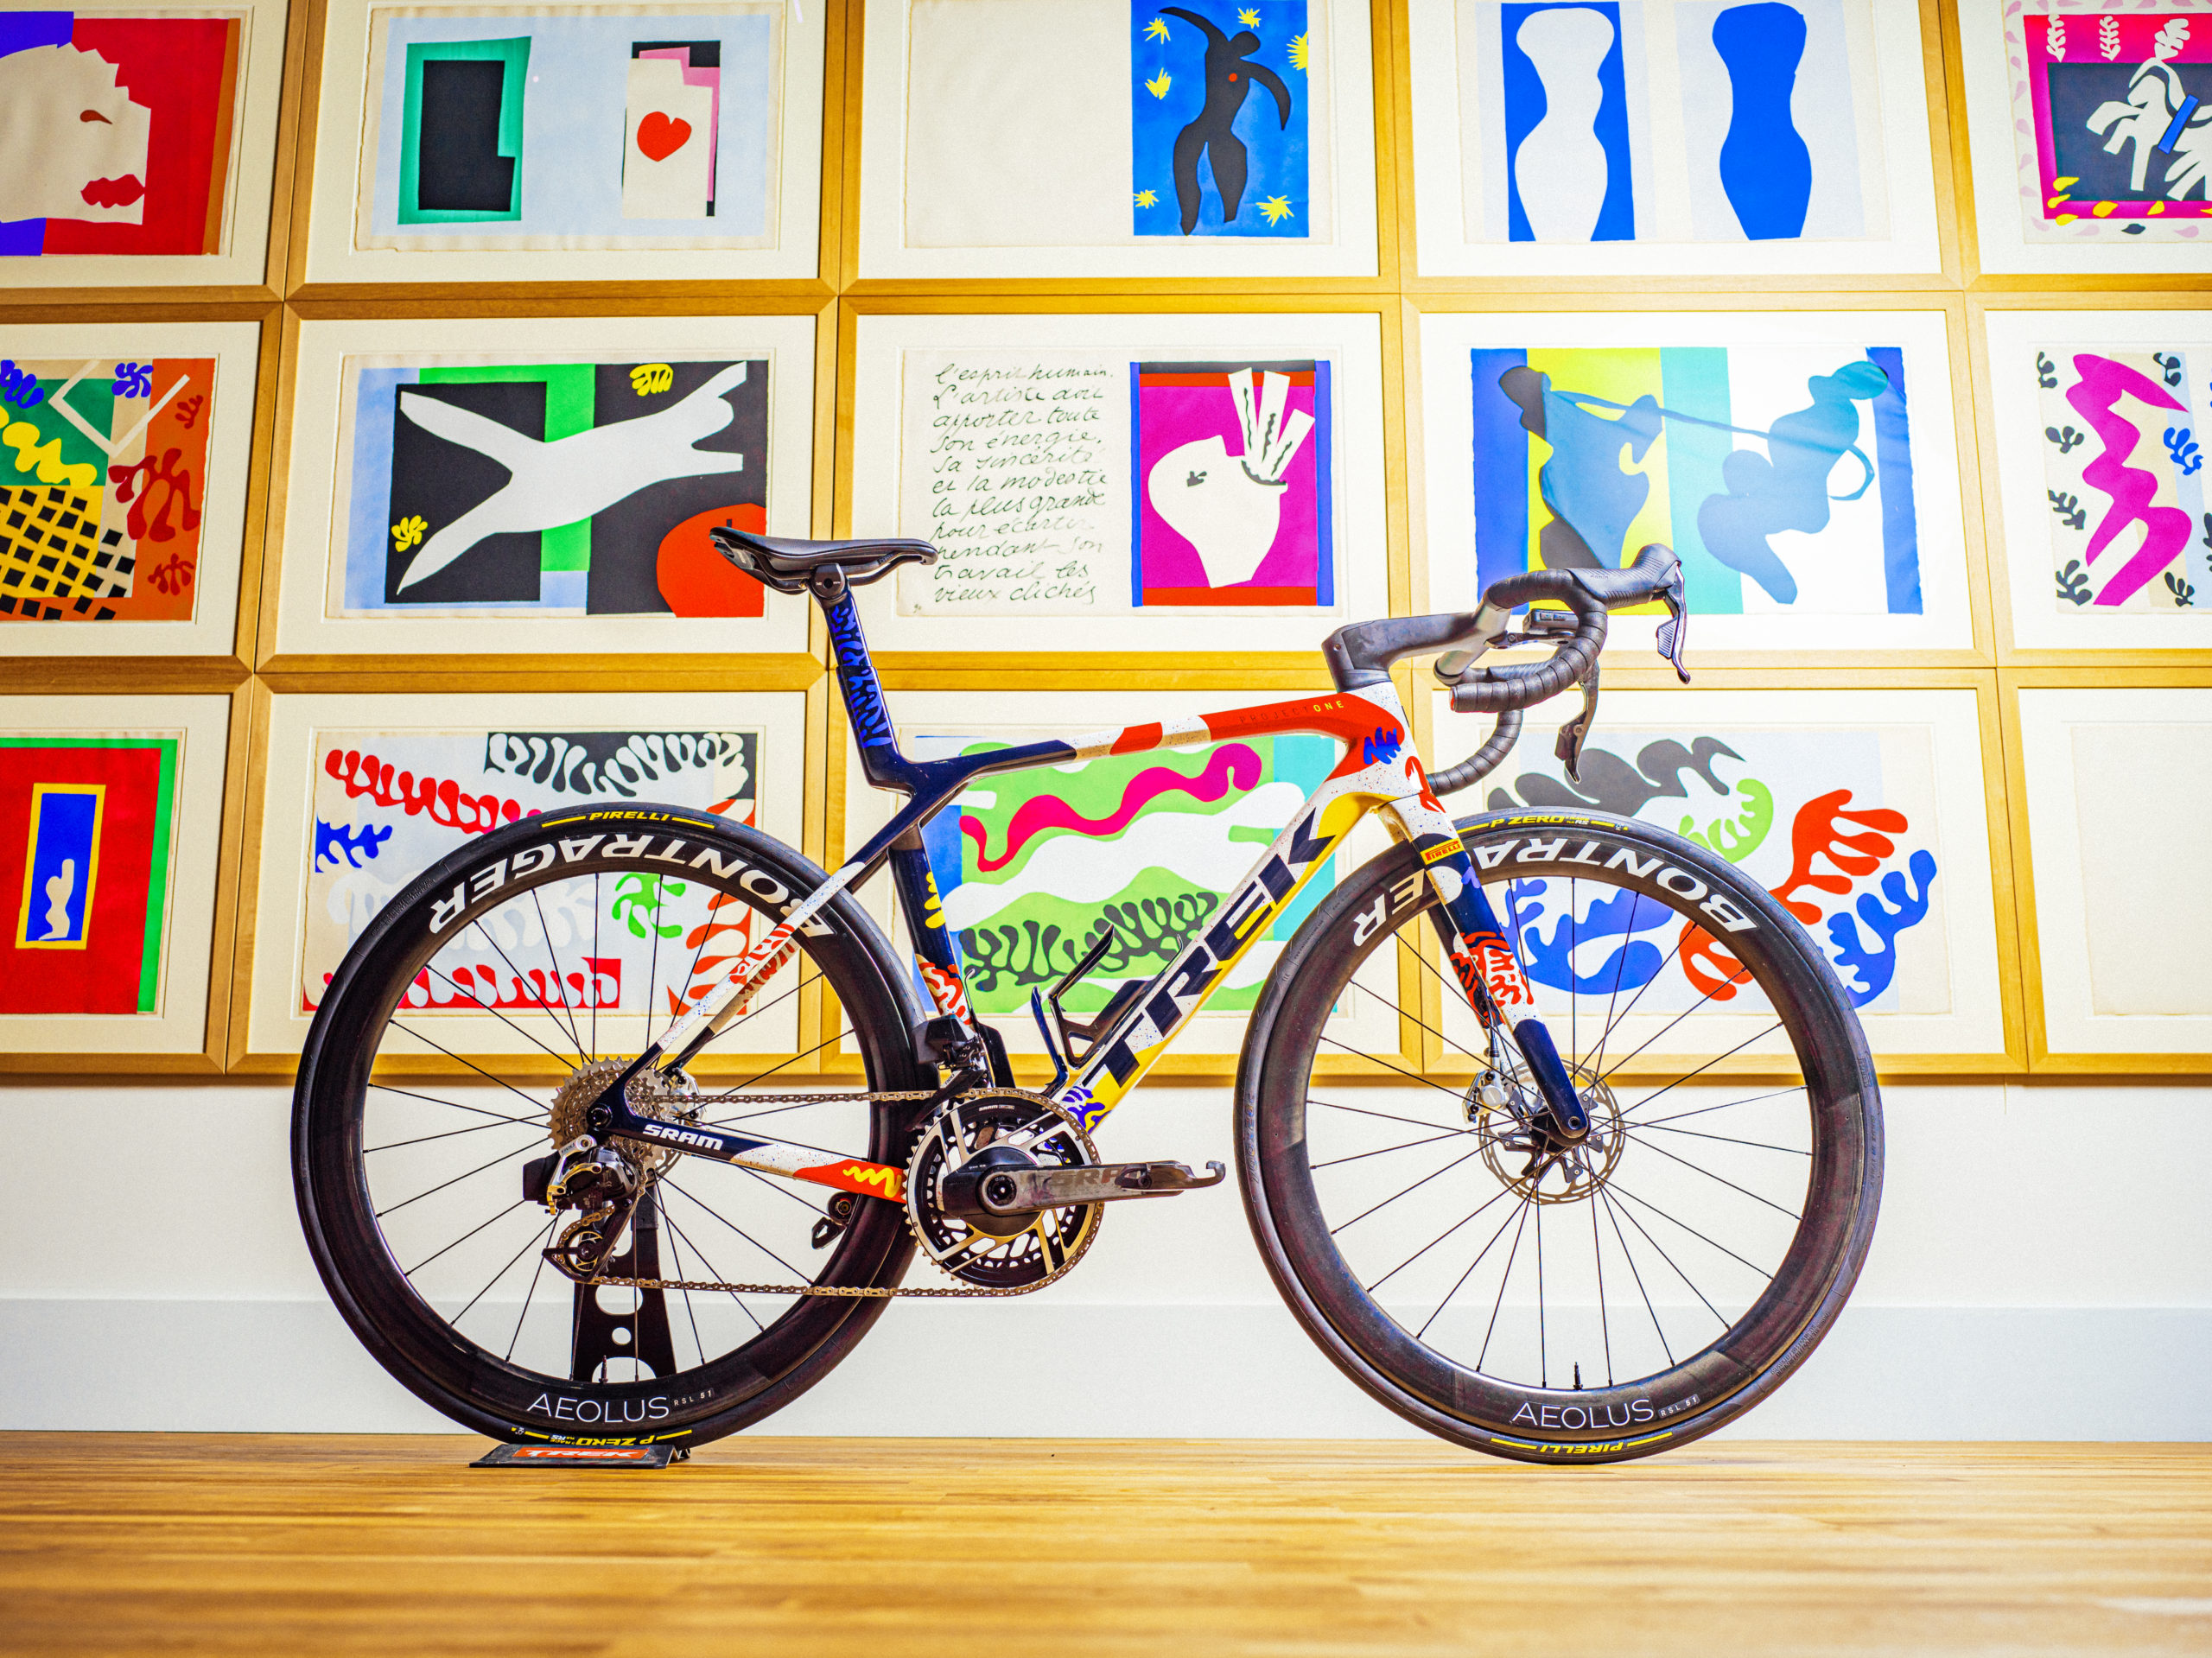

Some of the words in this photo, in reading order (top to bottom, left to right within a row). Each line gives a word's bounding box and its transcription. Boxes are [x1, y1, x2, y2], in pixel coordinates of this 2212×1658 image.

[1052, 385, 1103, 401] doit
[932, 409, 1042, 441] apporter
[1047, 406, 1100, 424] toute
[932, 480, 956, 493] et
[967, 475, 992, 491] la
[1000, 467, 1107, 490] modestie
[932, 497, 961, 518] la
[961, 496, 1027, 522] plus
[1029, 488, 1106, 525] grande
[928, 521, 989, 543] pour
[934, 561, 1045, 580] travail
[1056, 561, 1089, 578] les
[934, 584, 1001, 604] vieux
[1009, 581, 1096, 604] clichés
[1239, 706, 1308, 723] PROJECT
[1313, 701, 1344, 713] ONE
[588, 810, 671, 822] PIRELLI
[1490, 818, 1505, 828] P
[1508, 815, 1565, 825] ZERO
[1425, 841, 1461, 861] PIRELLI
[1354, 837, 1758, 947] BONTRAER
[1083, 808, 1337, 1089] TREK
[642, 1124, 724, 1151] SRAM
[1051, 1167, 1126, 1186] SRA
[527, 1393, 670, 1423] AEOLUS
[674, 1396, 694, 1406] RSL
[700, 1389, 711, 1399] 51
[1512, 1399, 1655, 1430] AEOLUS
[1661, 1405, 1681, 1417] RSL
[1685, 1396, 1697, 1407] 51
[575, 1437, 637, 1446] ZERO
[640, 1435, 655, 1445] P
[1540, 1441, 1624, 1454] PIRELLI
